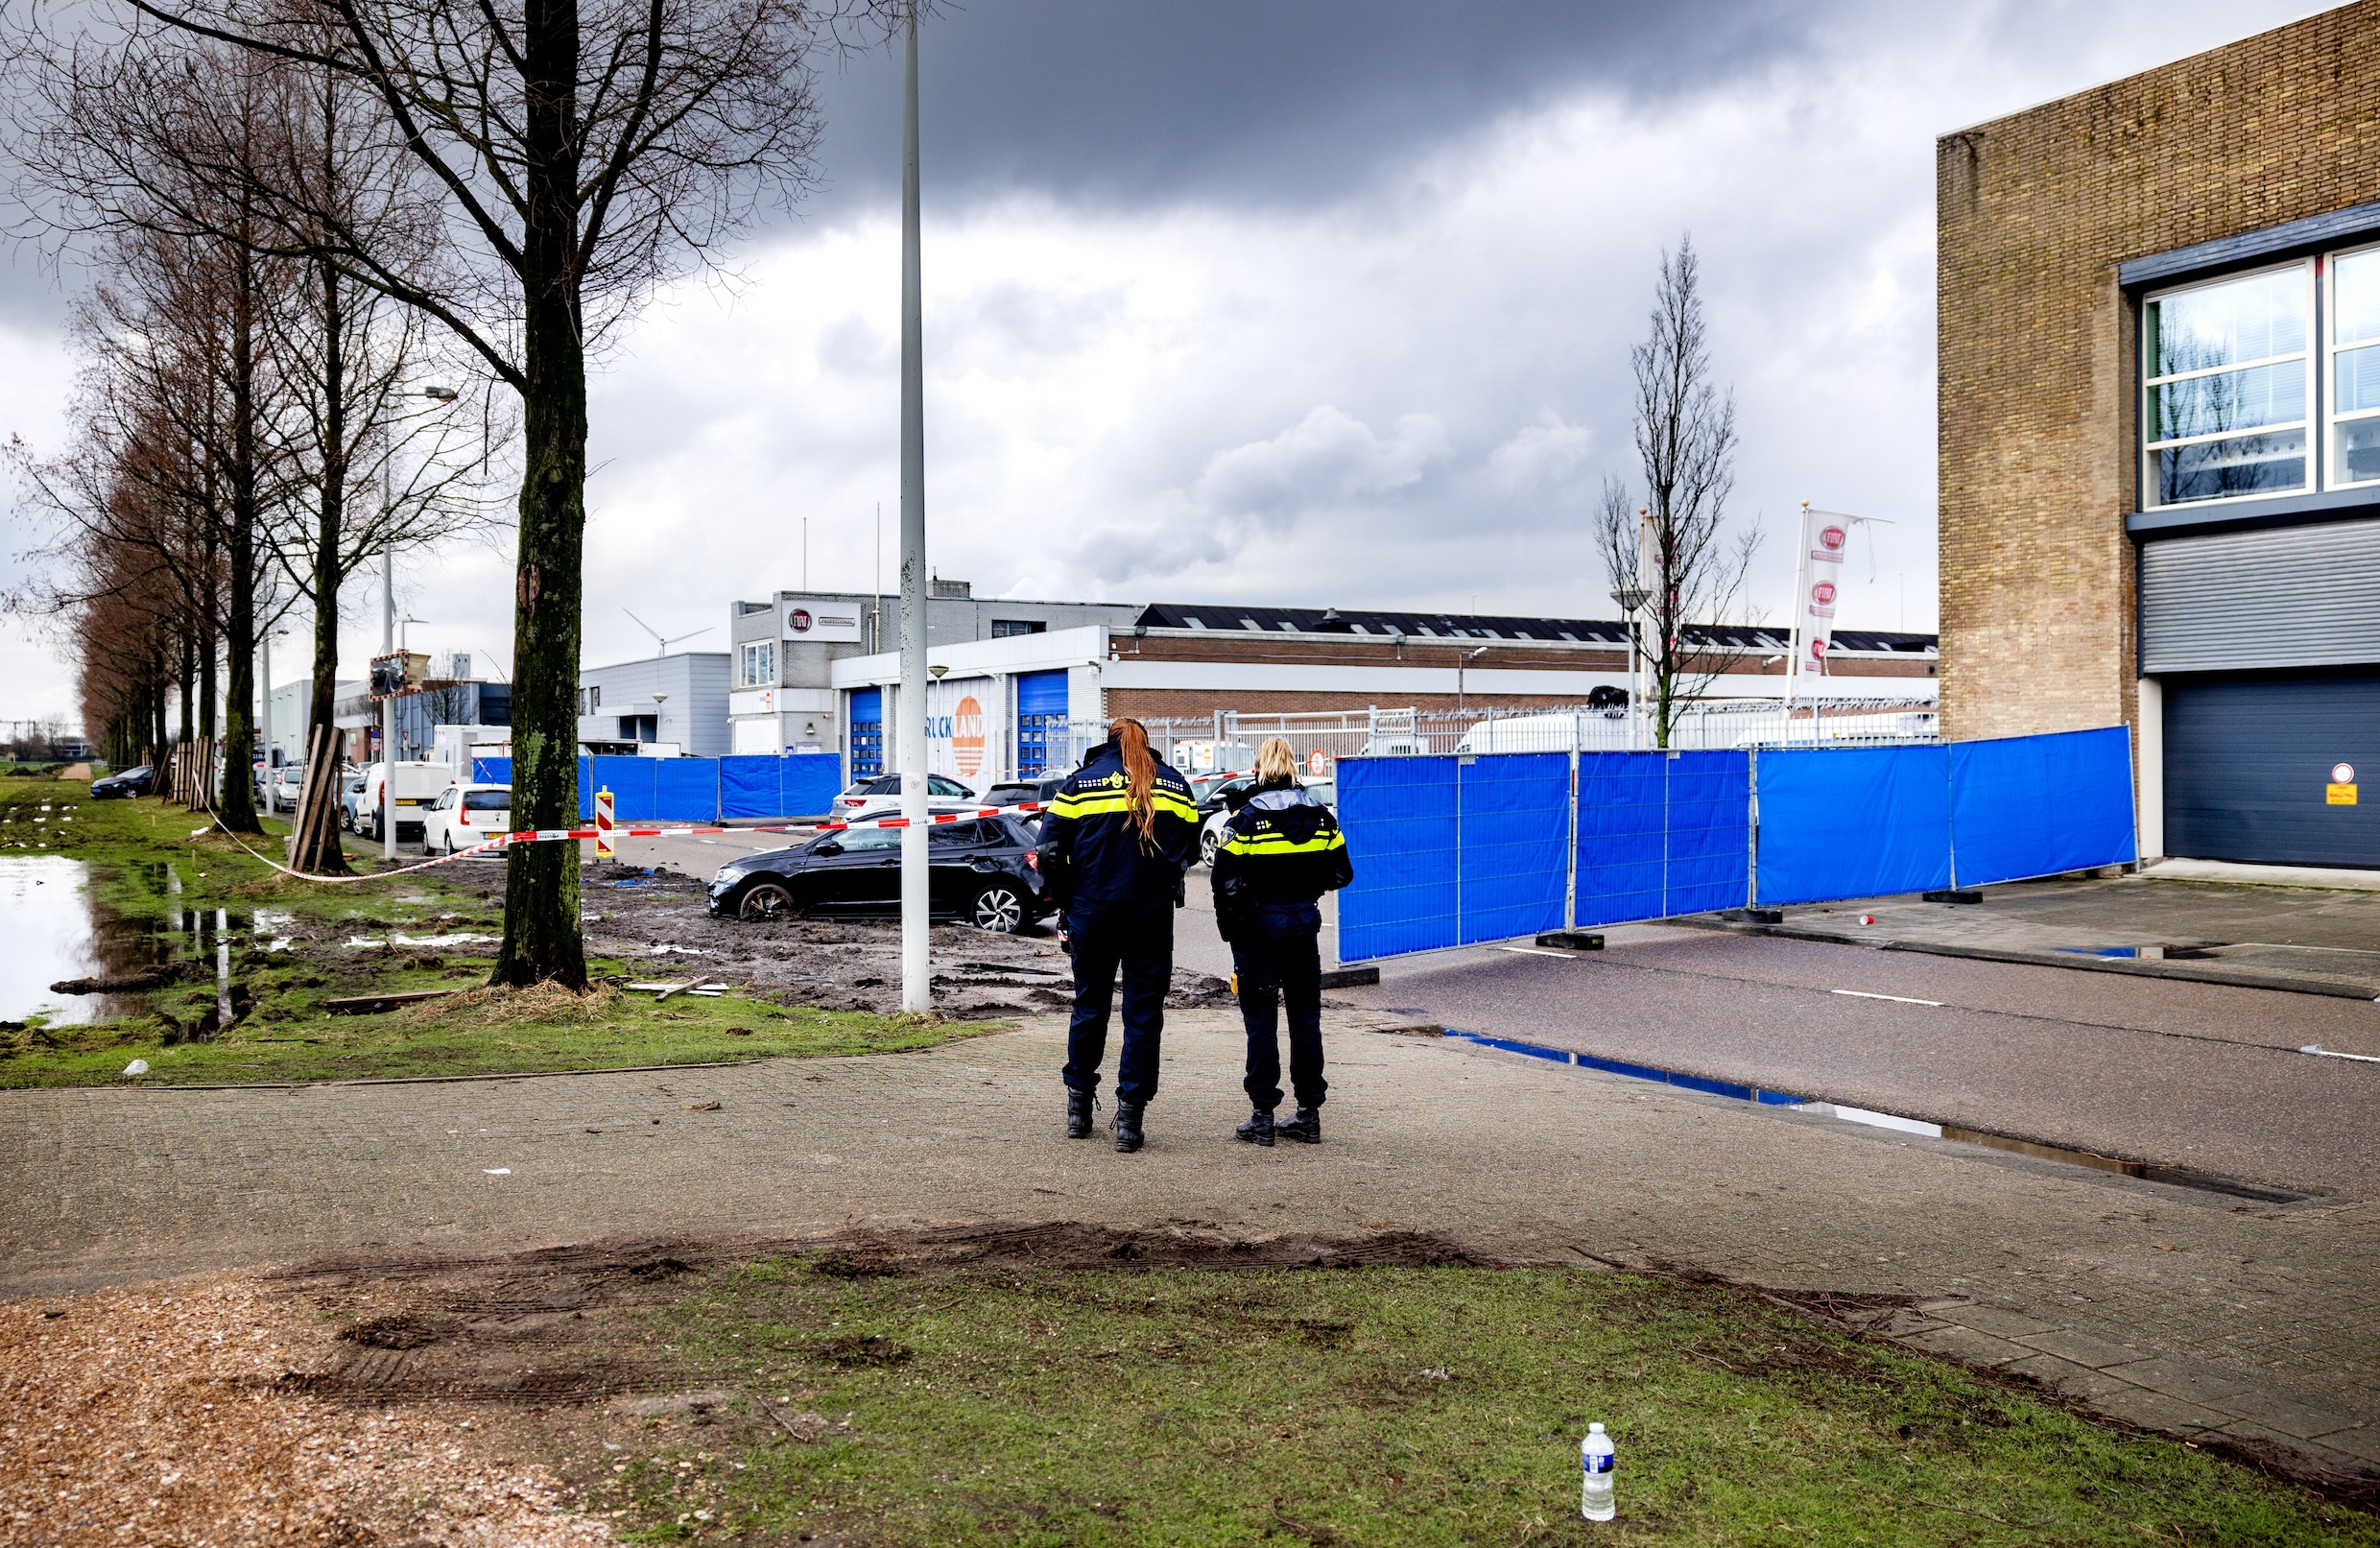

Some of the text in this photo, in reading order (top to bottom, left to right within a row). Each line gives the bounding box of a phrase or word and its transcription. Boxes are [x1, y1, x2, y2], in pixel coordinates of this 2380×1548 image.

[1827, 532, 1842, 544] FIAT
[1819, 586, 1833, 599] FIAT
[793, 614, 808, 628] FIAT
[926, 714, 985, 739] RUCKLAND
[1101, 771, 1163, 789] POLE
